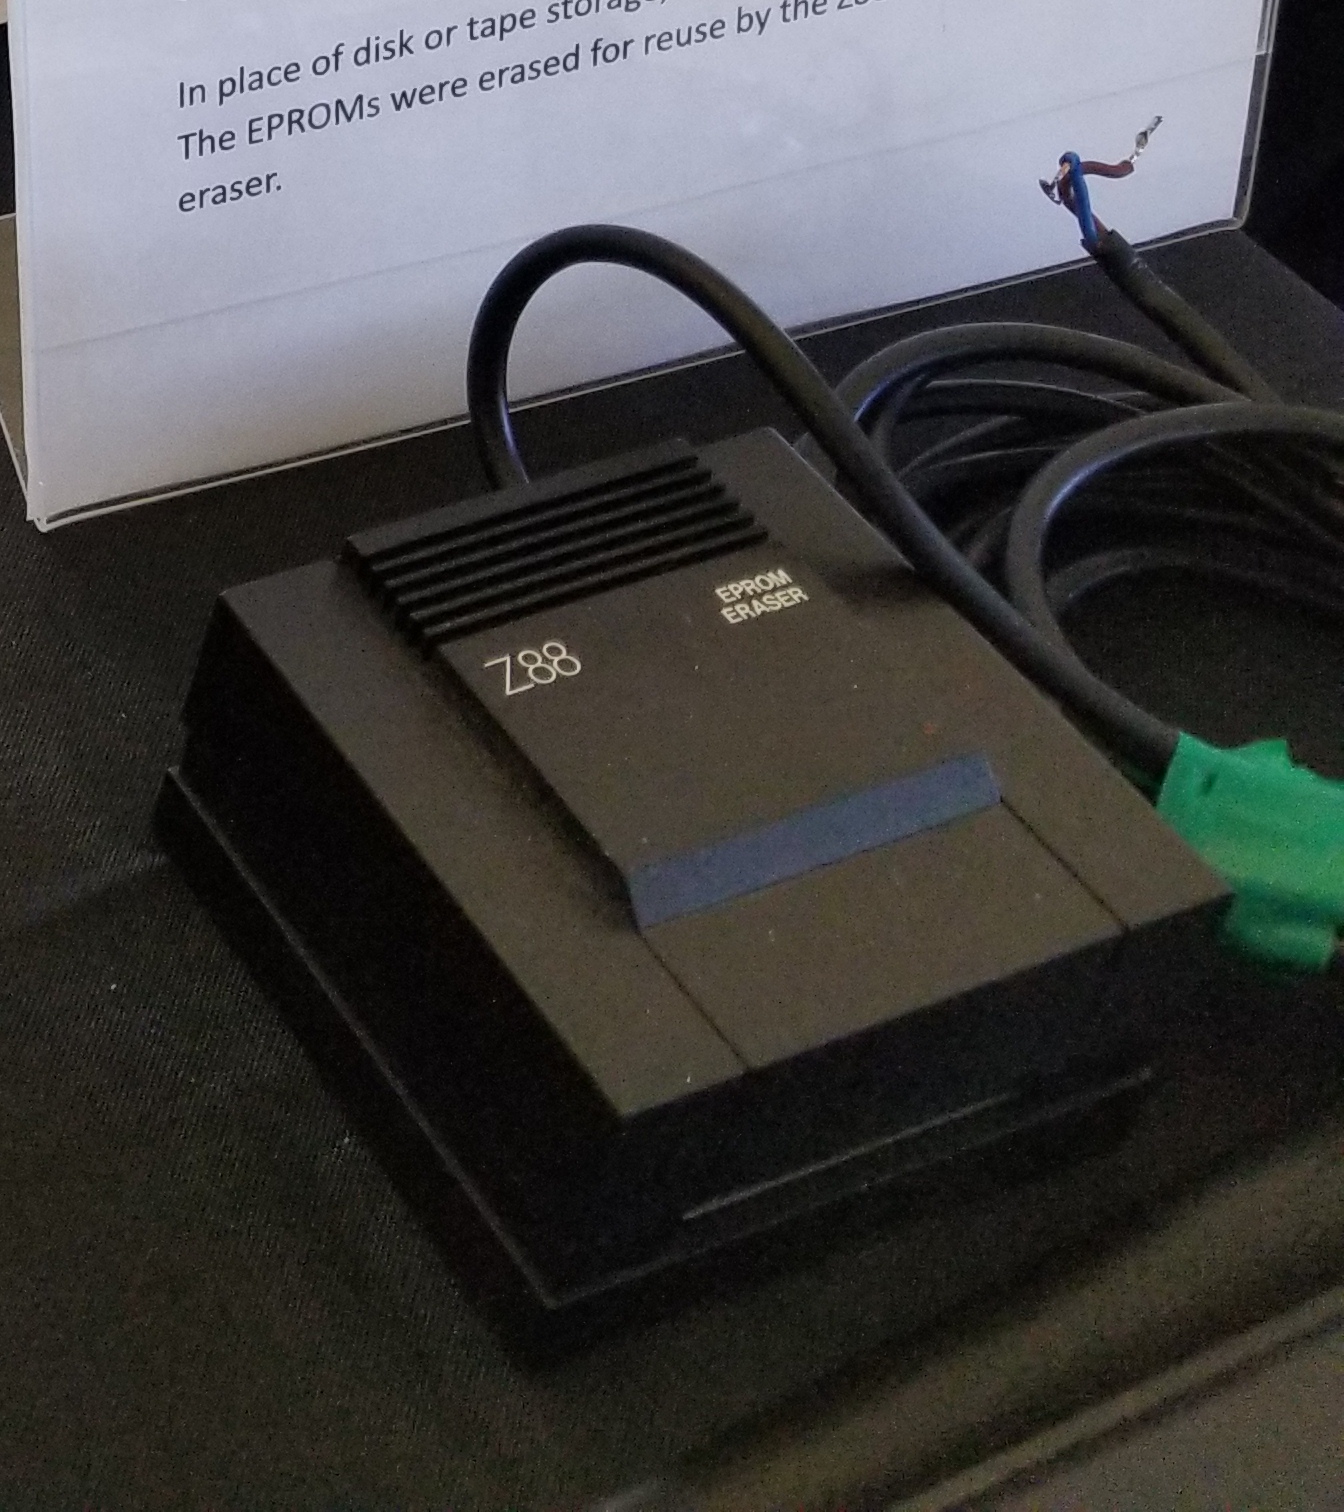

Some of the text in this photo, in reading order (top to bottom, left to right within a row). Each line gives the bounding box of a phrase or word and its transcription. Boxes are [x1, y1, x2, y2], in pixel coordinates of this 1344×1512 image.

[180, 82, 205, 108] In
[219, 62, 300, 106] place
[312, 42, 345, 76] of
[354, 29, 414, 67] disk
[425, 25, 458, 50] or
[467, 8, 536, 41] tape
[177, 128, 235, 160] The
[248, 94, 380, 145] EPROMs
[390, 78, 467, 111] were
[479, 43, 580, 91] erased
[590, 38, 635, 67] for
[645, 19, 725, 56] reuse
[737, 6, 772, 36] by
[179, 172, 282, 212] eraser.
[715, 568, 792, 604] EPROM
[721, 586, 809, 624] ERASER
[484, 642, 581, 695] Z88
